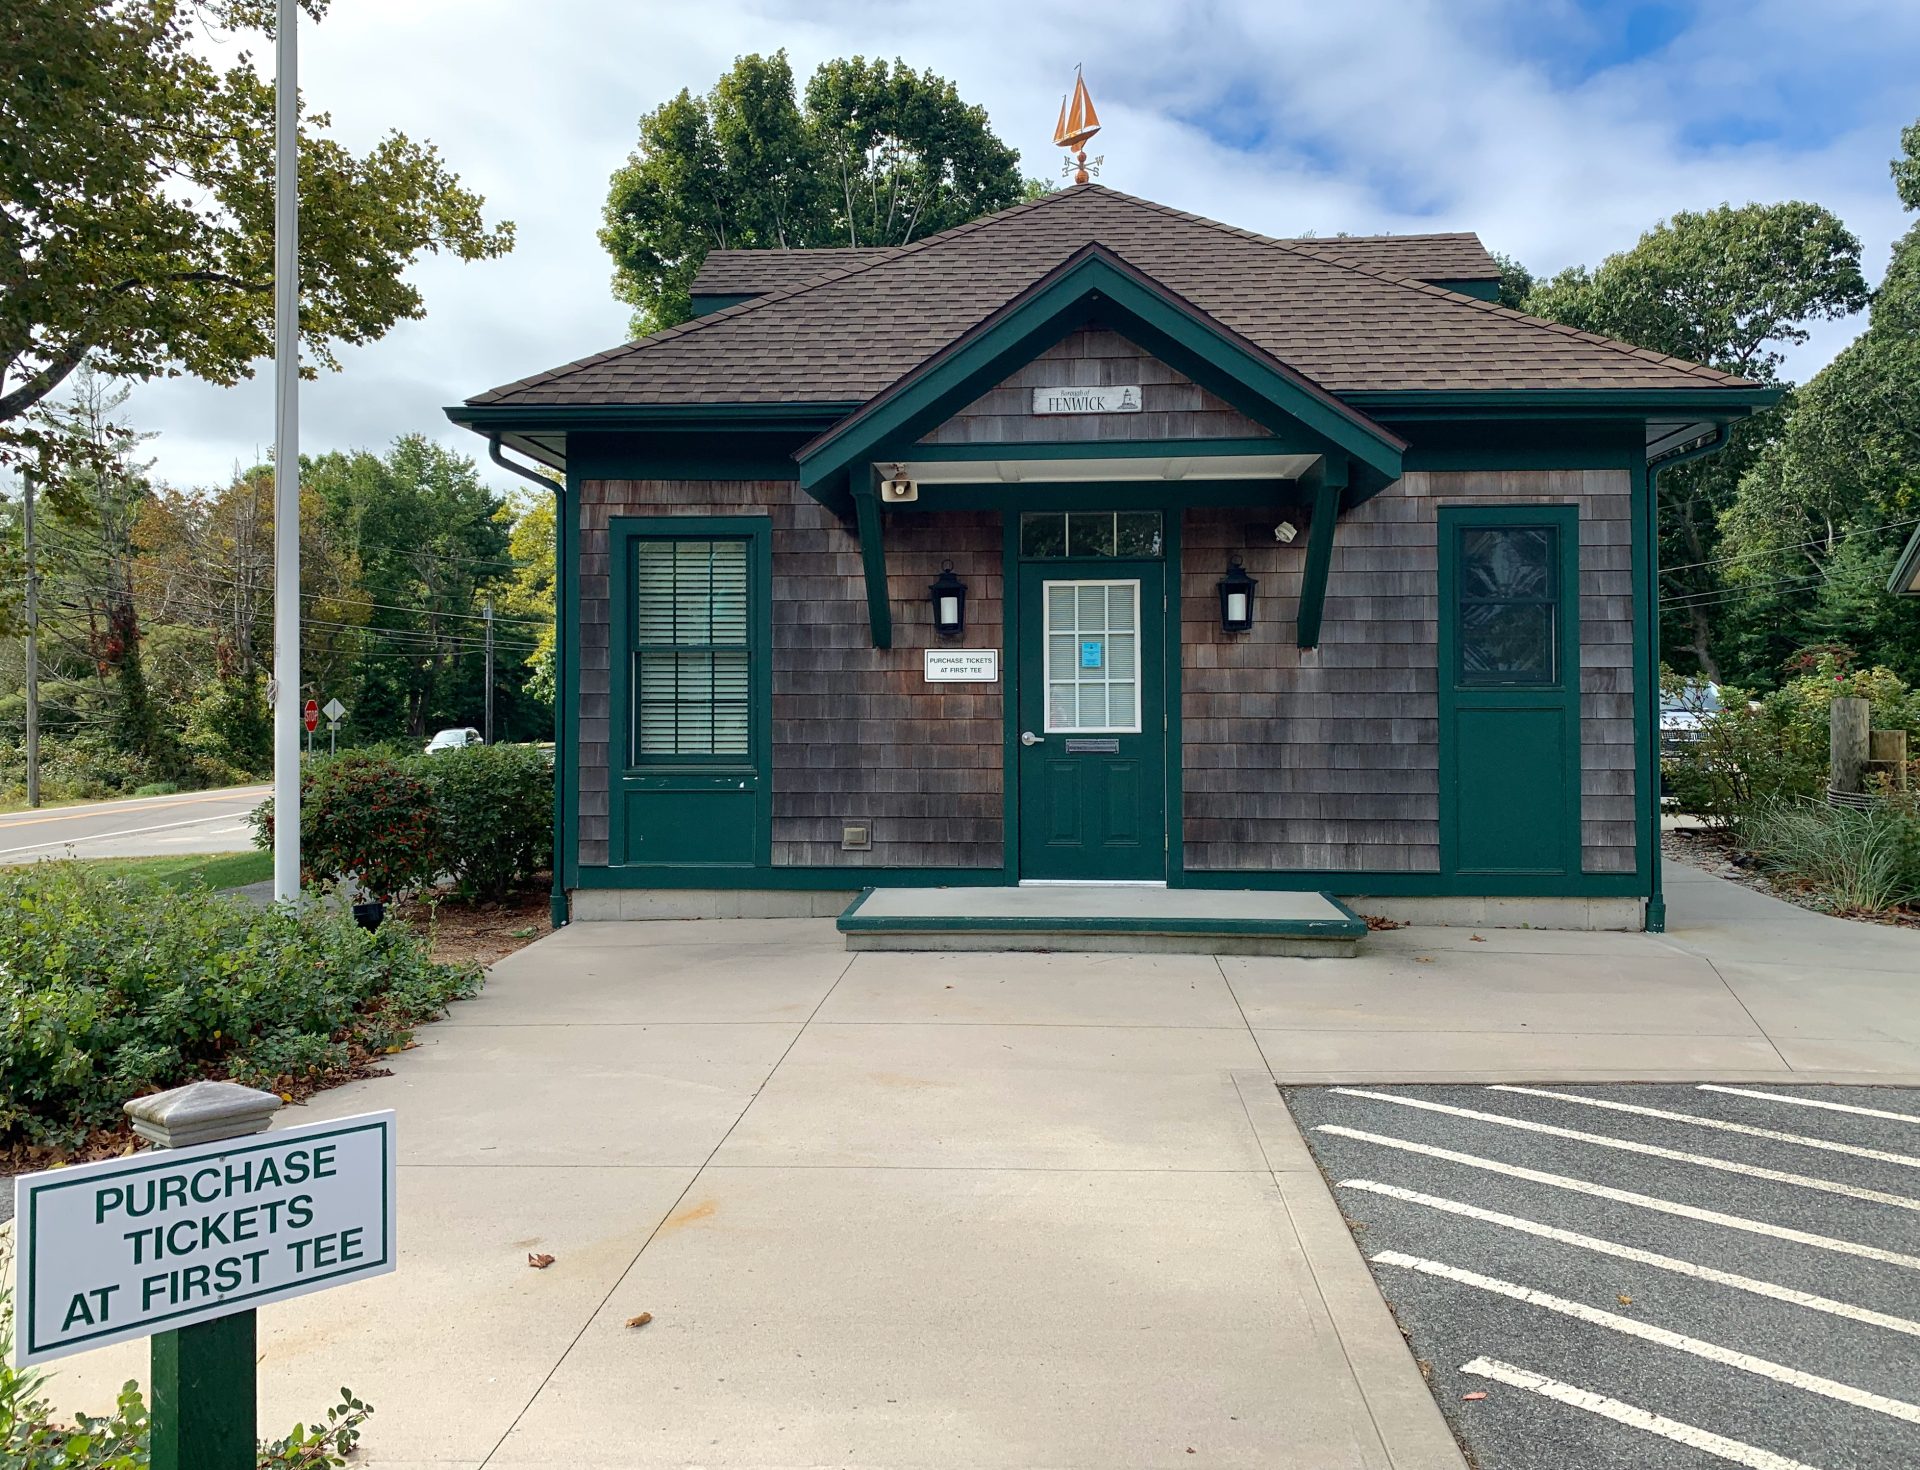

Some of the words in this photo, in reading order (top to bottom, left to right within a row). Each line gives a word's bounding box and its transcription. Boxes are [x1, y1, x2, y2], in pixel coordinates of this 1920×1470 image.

[1049, 397, 1105, 411] FENWICK
[305, 710, 318, 721] STOP
[95, 1144, 337, 1225] PURCHASE
[123, 1194, 314, 1265] TICKETS
[61, 1284, 120, 1332] AT
[142, 1249, 270, 1312] FIRST
[287, 1227, 364, 1273] TEE
